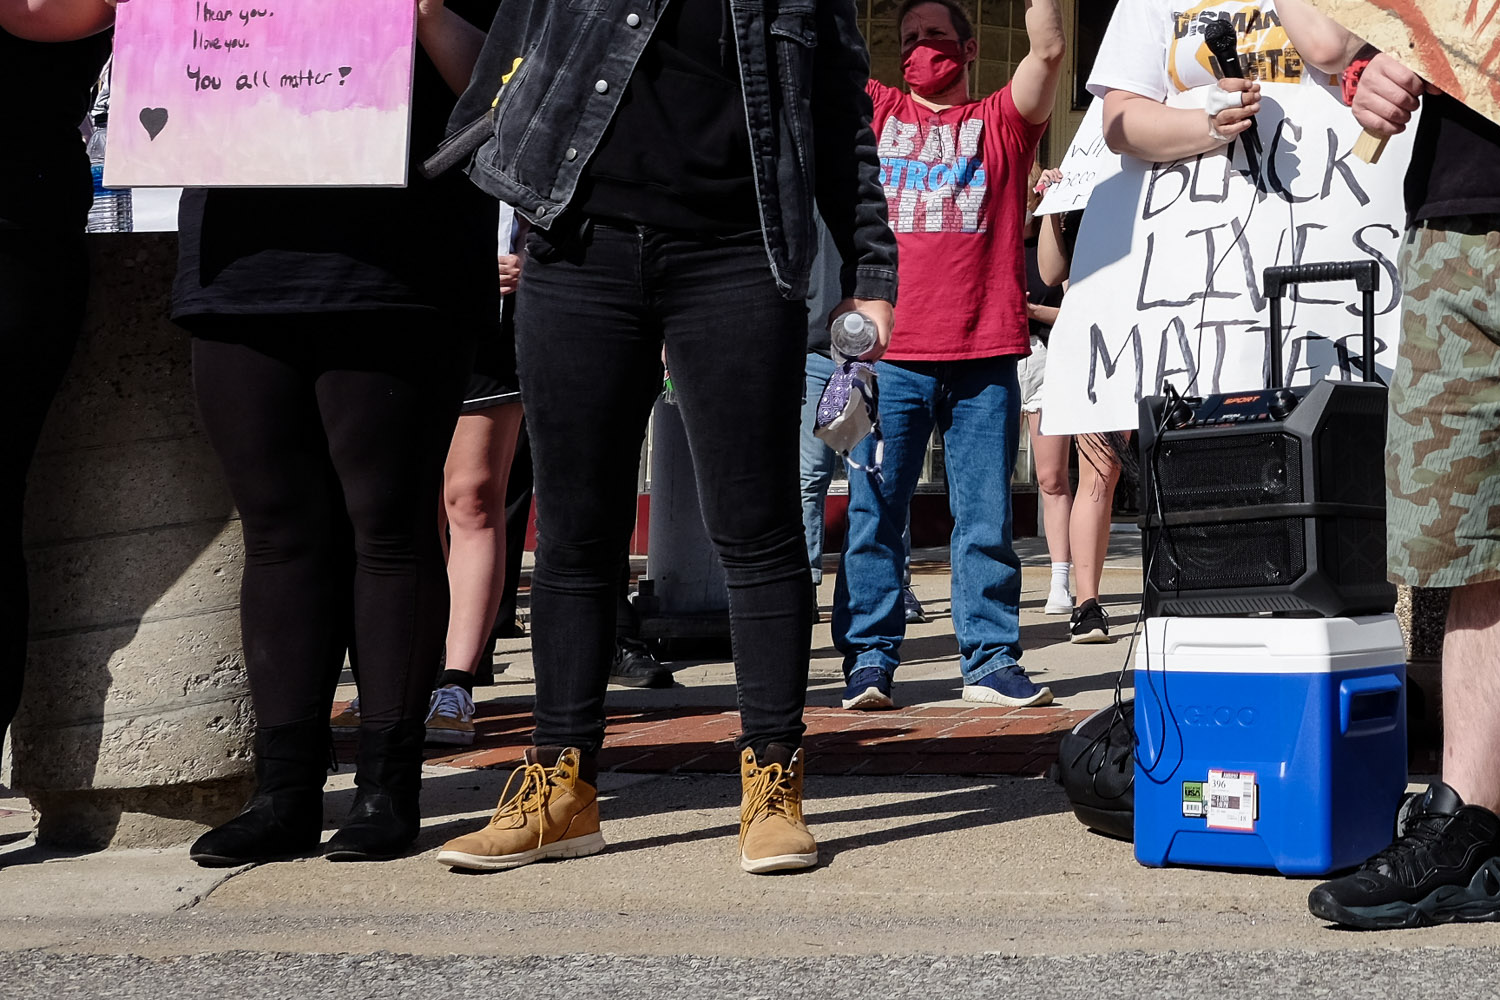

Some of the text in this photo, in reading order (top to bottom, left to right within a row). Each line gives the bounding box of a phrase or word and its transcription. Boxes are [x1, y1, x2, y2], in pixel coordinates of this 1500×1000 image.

[196, 1, 275, 27] I hear you.
[1173, 8, 1283, 41] DISMAN
[224, 37, 250, 53] you.
[186, 64, 222, 92] You
[235, 71, 270, 91] all
[877, 115, 984, 164] BAY
[1142, 117, 1370, 221] BLACK
[1136, 216, 1400, 317] LIVES
[1087, 315, 1390, 404] MATTER
[1223, 395, 1261, 404] SPORT
